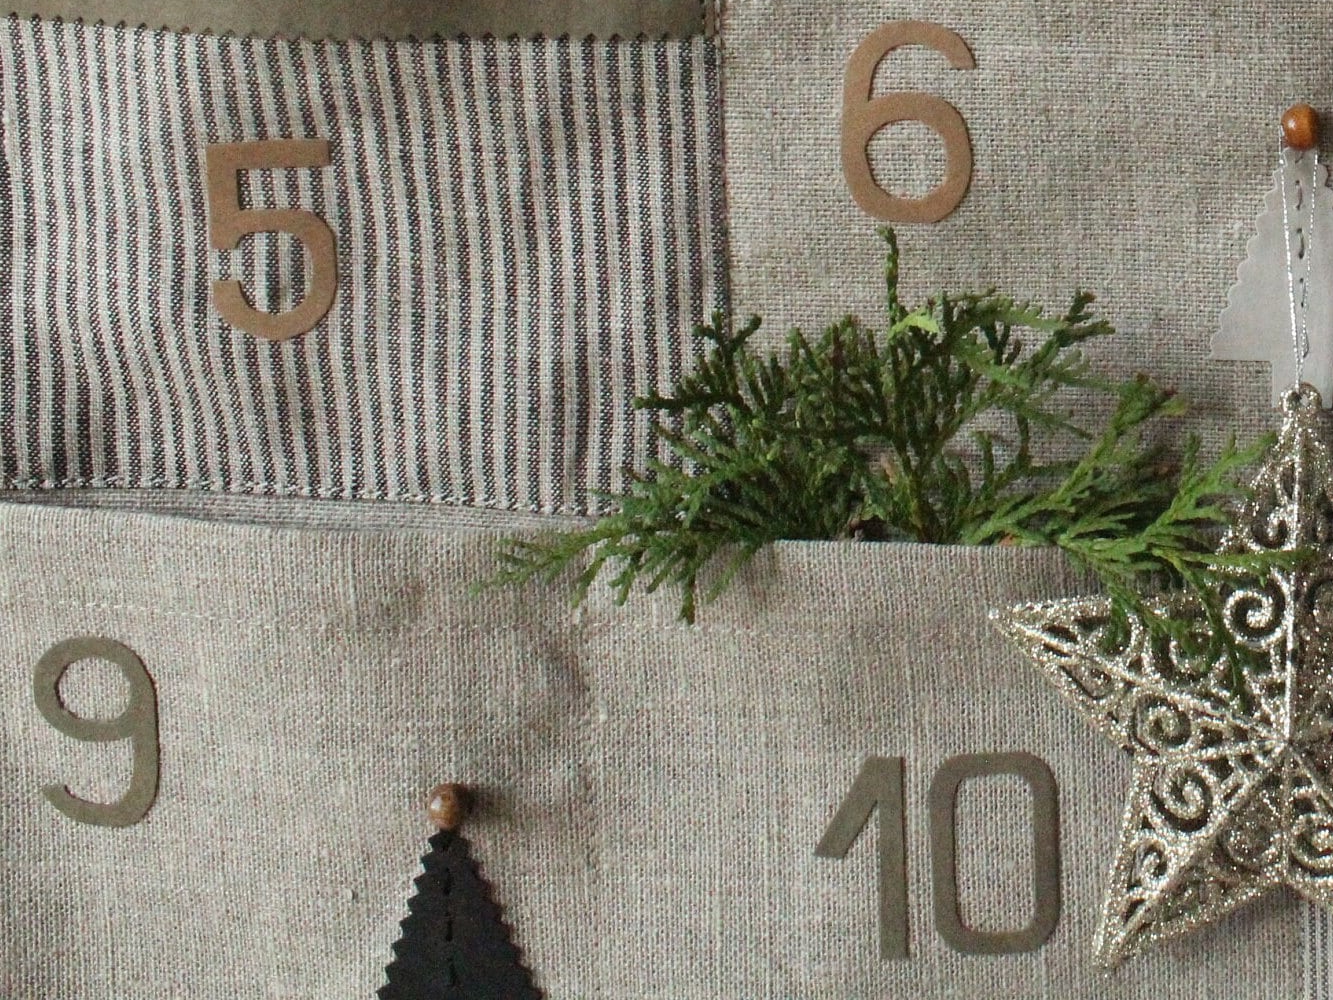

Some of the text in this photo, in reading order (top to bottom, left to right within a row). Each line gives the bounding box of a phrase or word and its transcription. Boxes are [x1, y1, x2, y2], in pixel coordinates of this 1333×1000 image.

[843, 21, 977, 223] 6
[204, 138, 337, 342] 5
[34, 636, 160, 829] 9
[817, 754, 1060, 958] 10
